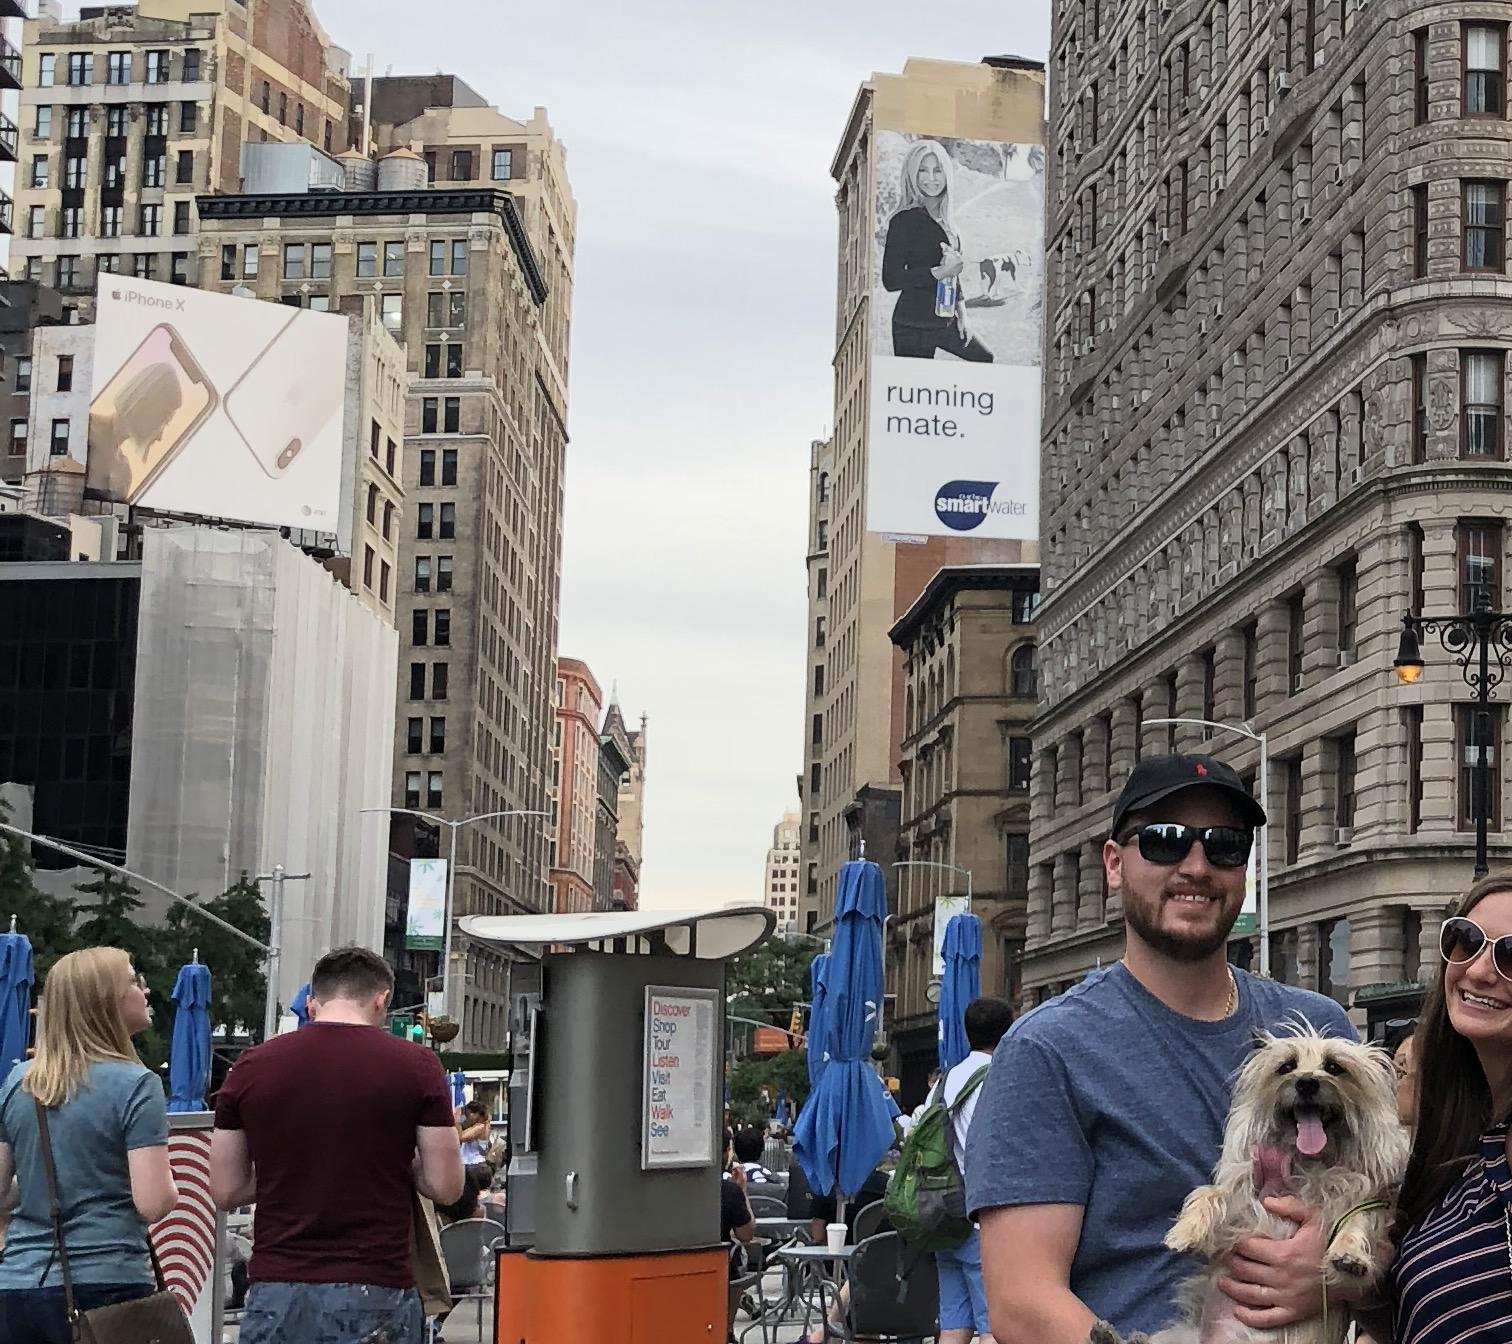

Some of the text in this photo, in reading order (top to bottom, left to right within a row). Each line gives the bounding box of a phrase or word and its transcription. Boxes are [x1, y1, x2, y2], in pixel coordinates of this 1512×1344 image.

[124, 290, 186, 312] iPhone X
[887, 384, 994, 416] running
[887, 414, 965, 438] mate.
[653, 1001, 691, 1017] Discover
[653, 1019, 677, 1036] Shop
[653, 1036, 671, 1050] Tour
[652, 1055, 679, 1068] Listen
[652, 1071, 671, 1085] Visit
[651, 1089, 667, 1102] Eat
[651, 1106, 674, 1120] Walk
[650, 1122, 669, 1137] See
